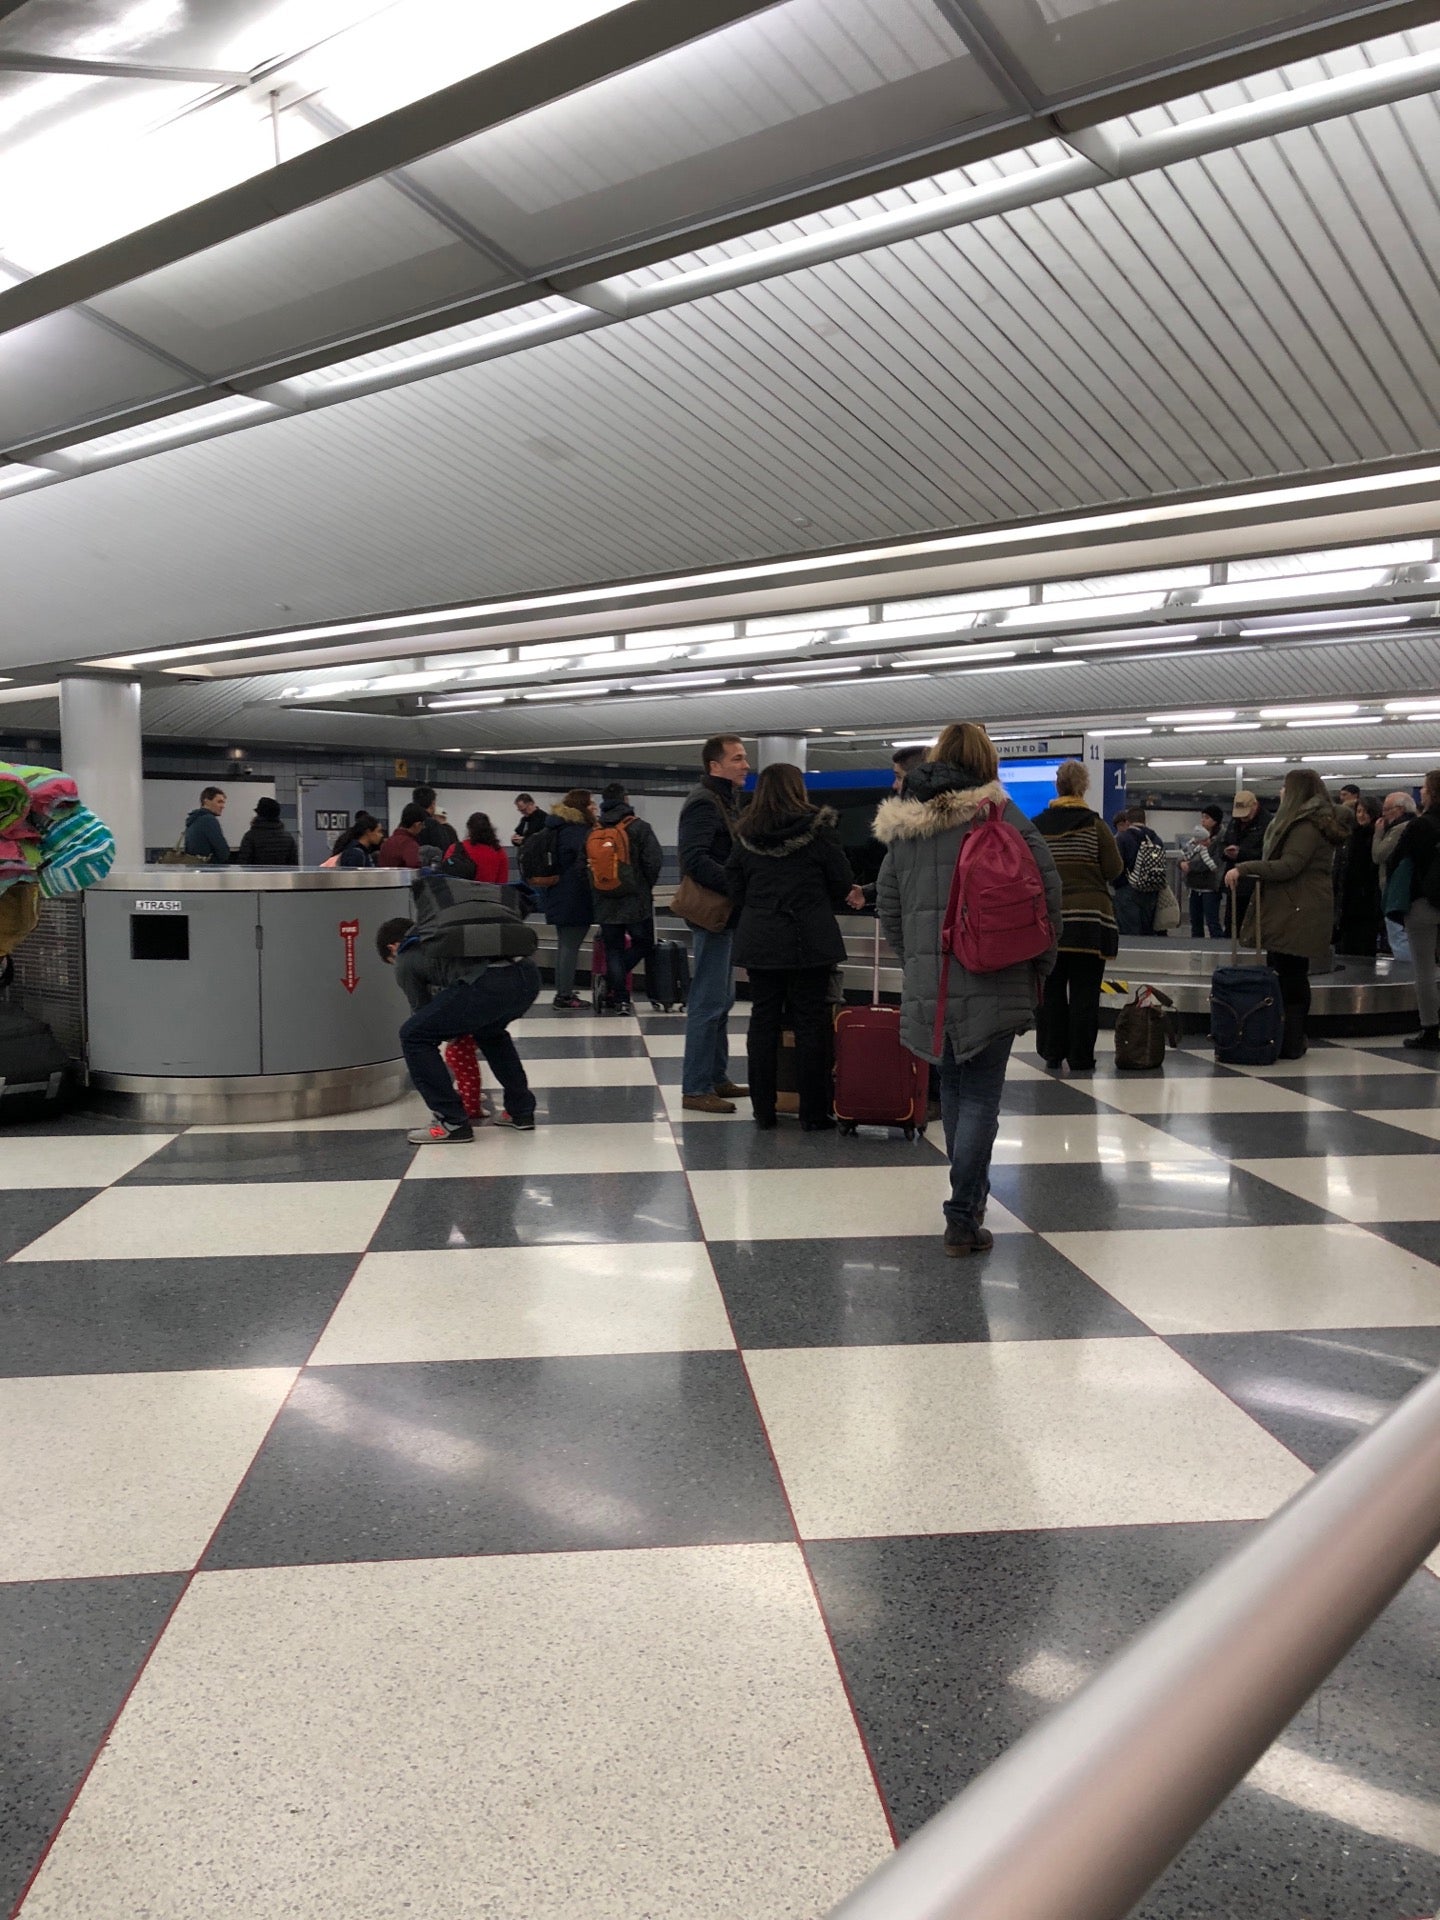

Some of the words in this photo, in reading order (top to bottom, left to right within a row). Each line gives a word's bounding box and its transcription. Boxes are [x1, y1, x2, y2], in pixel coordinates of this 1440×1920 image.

[997, 745, 1035, 753] UNITED
[1090, 744, 1099, 760] 11
[1114, 768, 1127, 790] 1
[317, 813, 329, 828] NO
[331, 813, 347, 828] EXIT
[144, 901, 180, 909] TRASH
[430, 1126, 445, 1138] N
